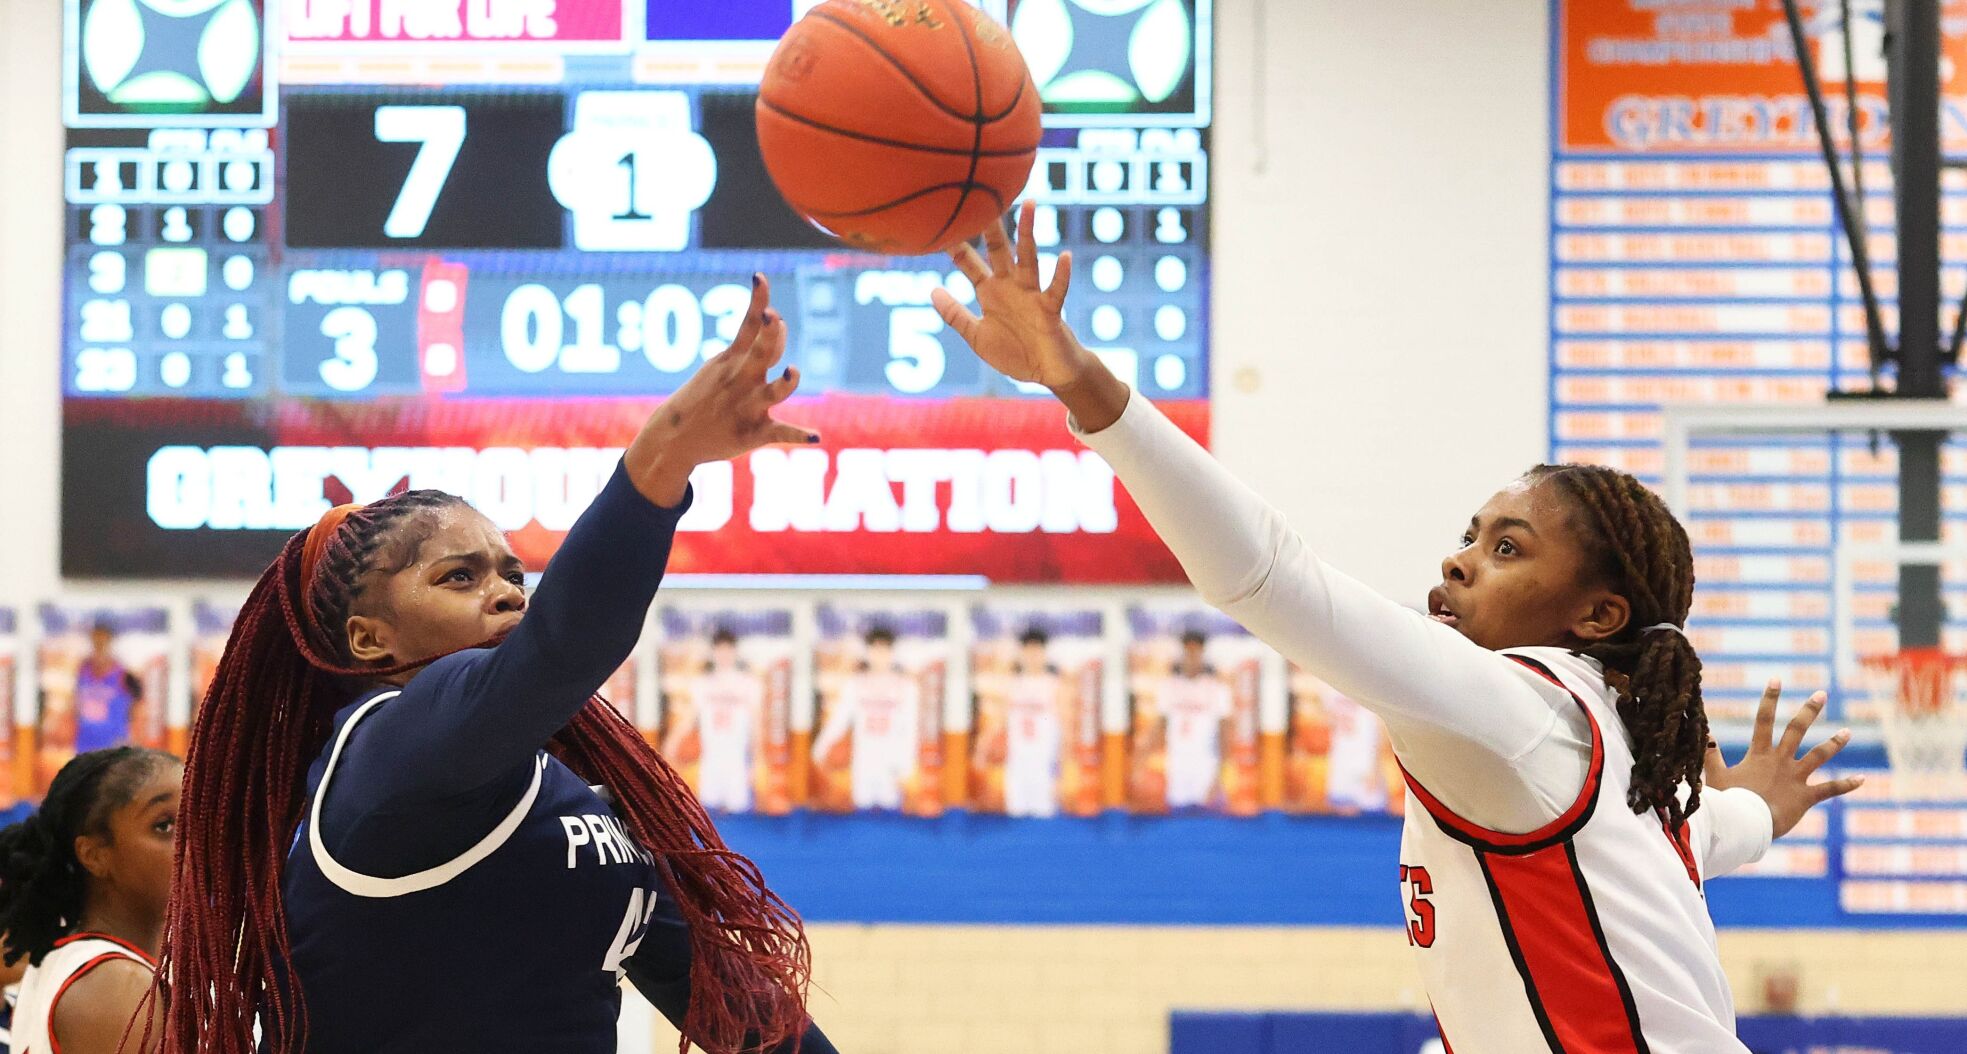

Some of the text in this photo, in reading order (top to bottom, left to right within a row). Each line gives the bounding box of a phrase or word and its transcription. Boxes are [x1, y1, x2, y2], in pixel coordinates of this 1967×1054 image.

[374, 105, 467, 238] 7
[611, 152, 653, 220] 1
[318, 306, 379, 392] 3
[501, 283, 753, 373] 01:03
[884, 306, 946, 394] 5
[748, 448, 1118, 533] NATION
[559, 814, 655, 869] PRIN
